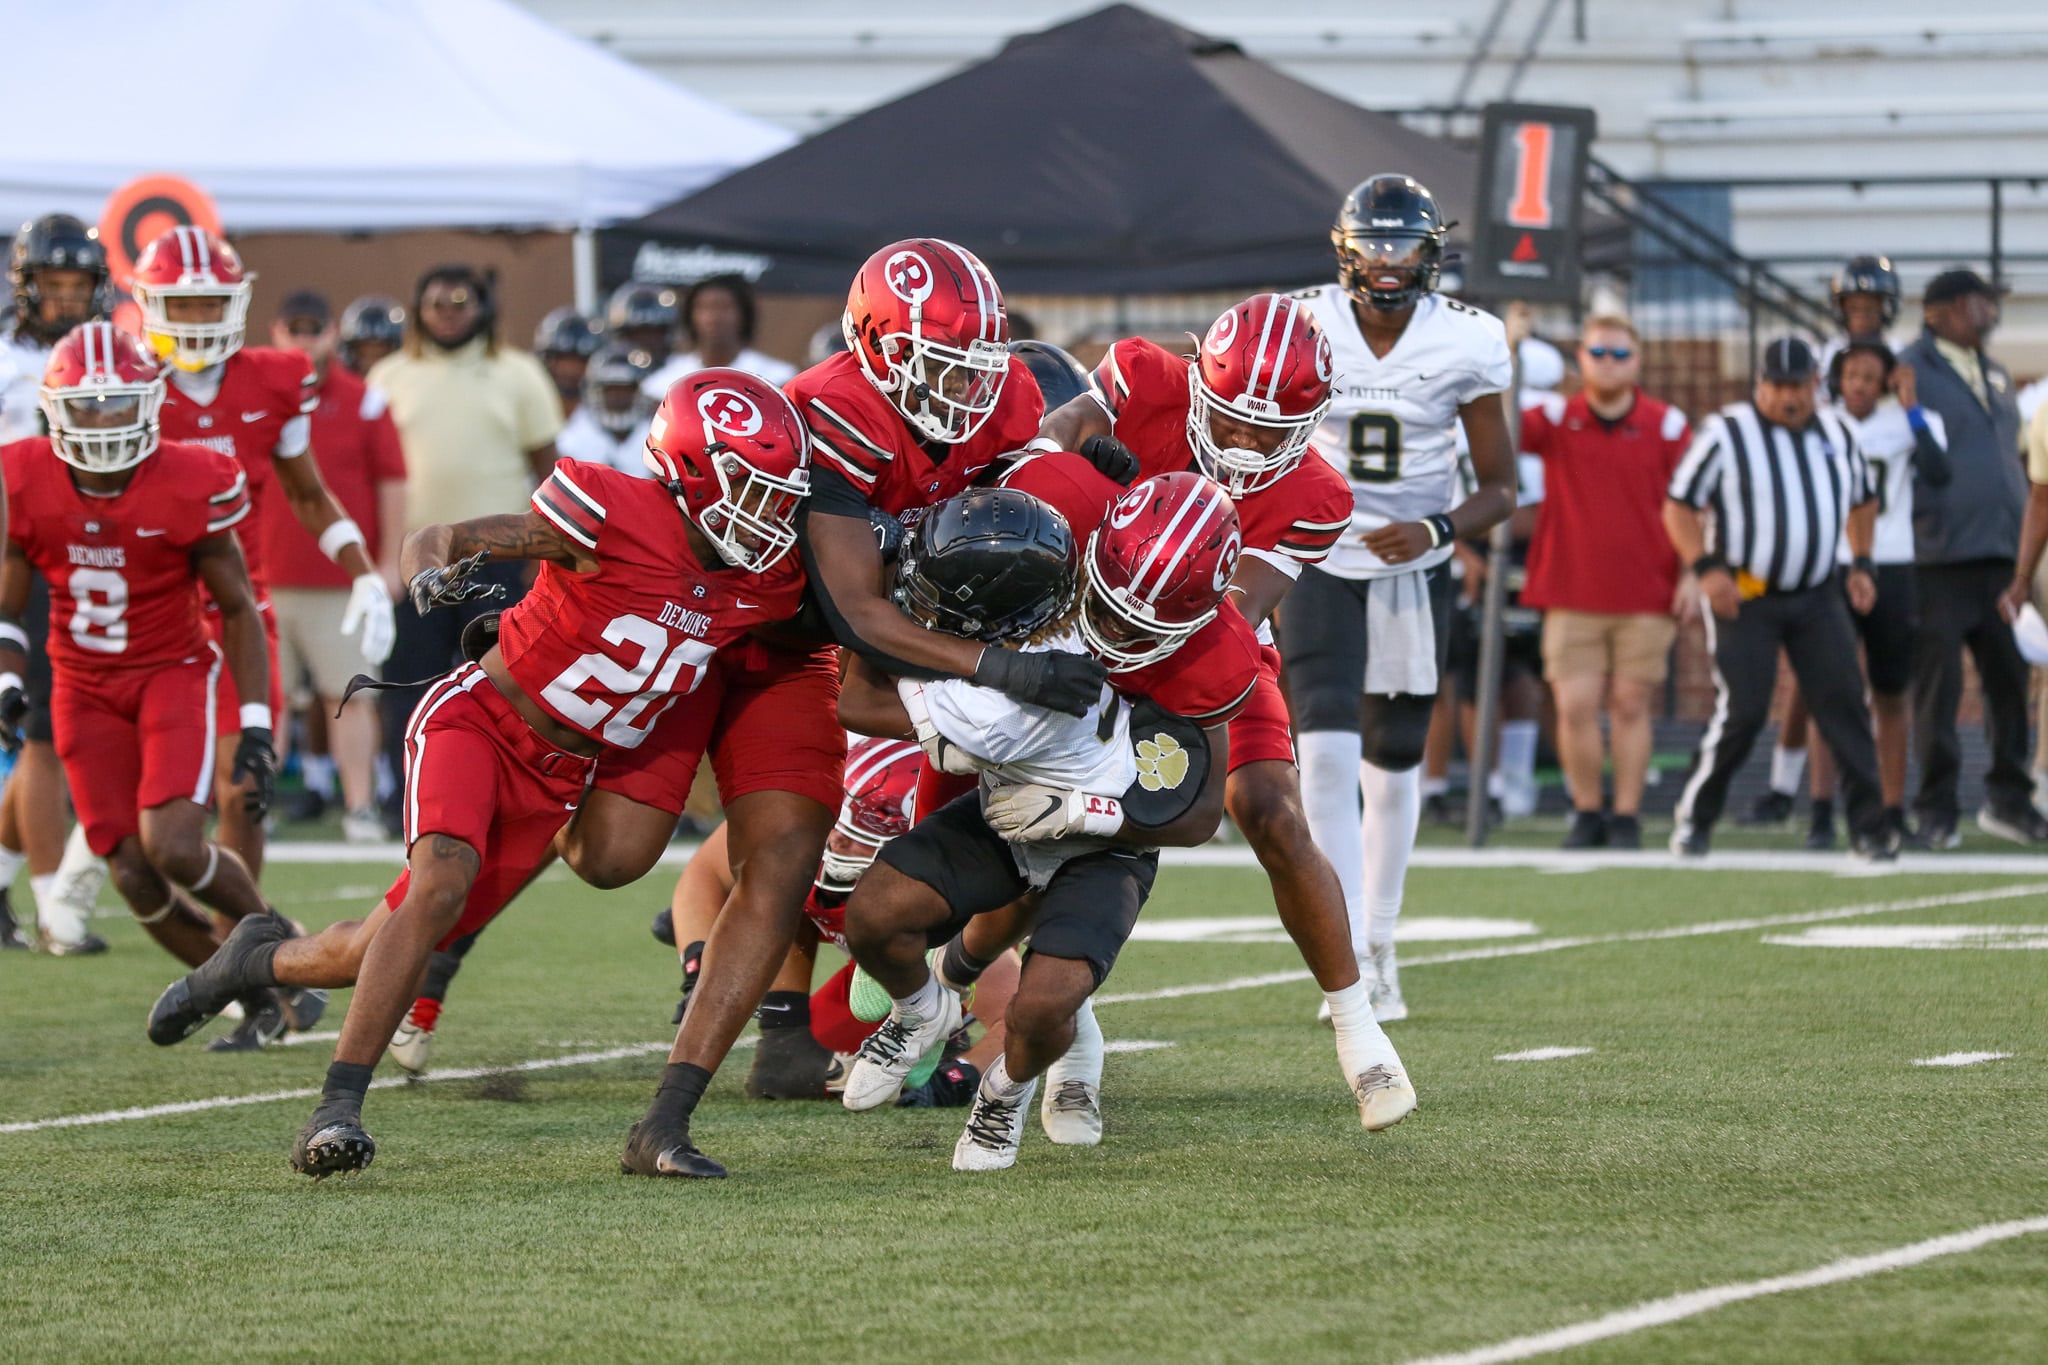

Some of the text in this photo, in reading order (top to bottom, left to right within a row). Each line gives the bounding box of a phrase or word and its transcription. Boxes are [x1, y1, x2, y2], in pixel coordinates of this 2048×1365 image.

[1508, 121, 1552, 228] 1
[703, 392, 755, 431] R
[1247, 399, 1268, 413] WAR
[1348, 410, 1403, 484] 9
[68, 546, 126, 567] DEMONS
[68, 567, 129, 654] 8
[656, 600, 713, 638] DEMONS
[1125, 593, 1145, 612] WAR
[539, 613, 718, 749] 20
